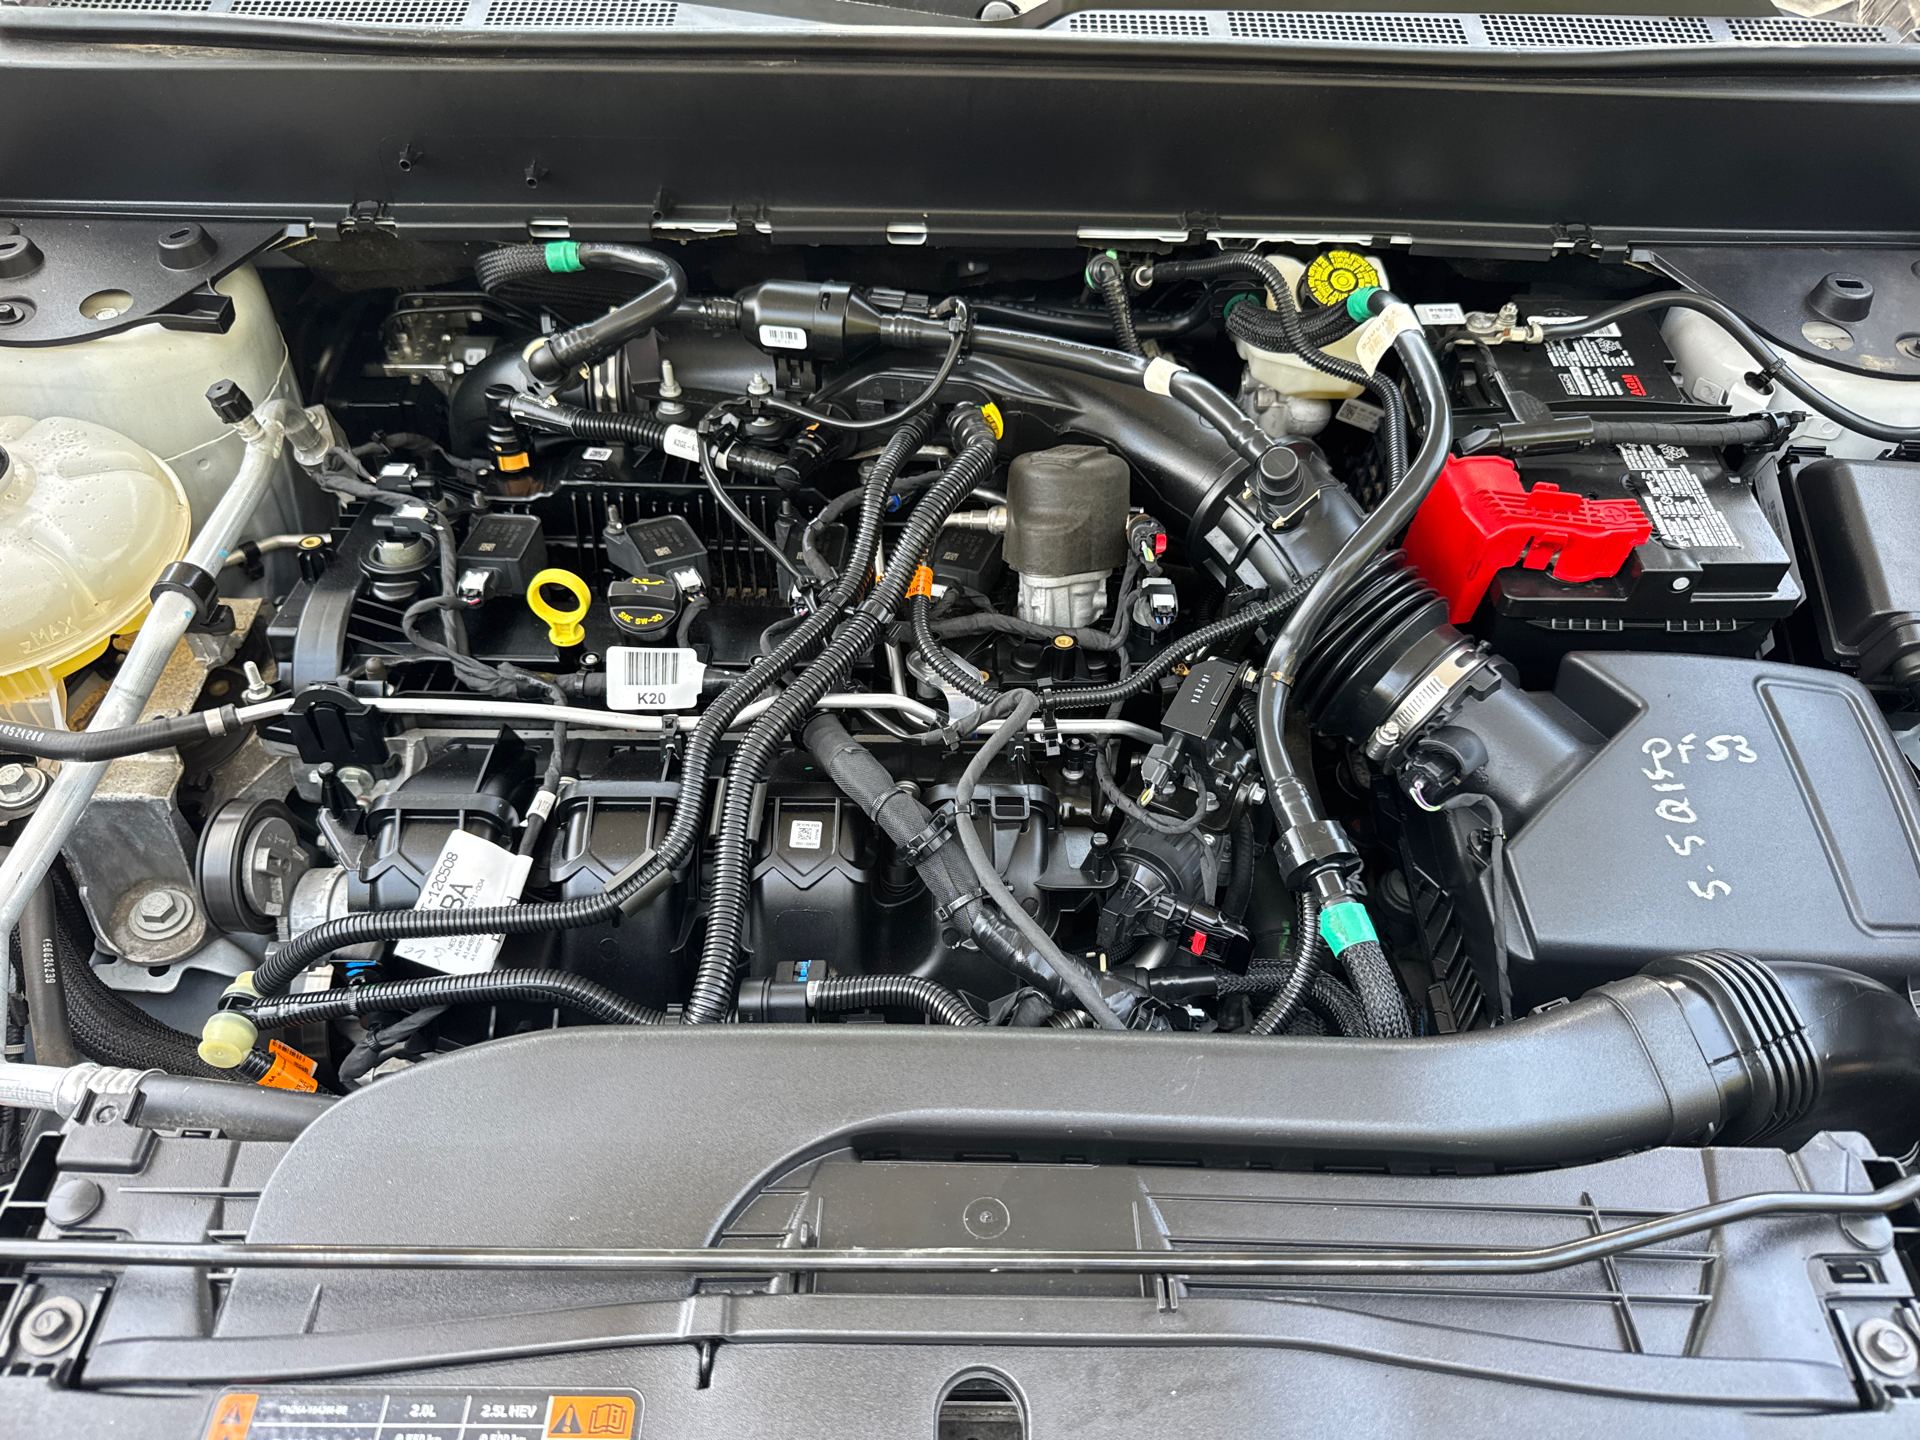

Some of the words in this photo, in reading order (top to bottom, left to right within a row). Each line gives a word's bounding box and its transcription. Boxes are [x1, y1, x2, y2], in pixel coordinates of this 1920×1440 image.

[1621, 374, 1643, 396] AGM
[618, 611, 633, 623] SAE
[635, 613, 663, 625] 5W-30
[29, 616, 80, 646] MAX
[637, 692, 666, 705] K20
[409, 1403, 437, 1418] 2.0L
[480, 1404, 507, 1418] 2.5L
[508, 1404, 538, 1418] HEV
